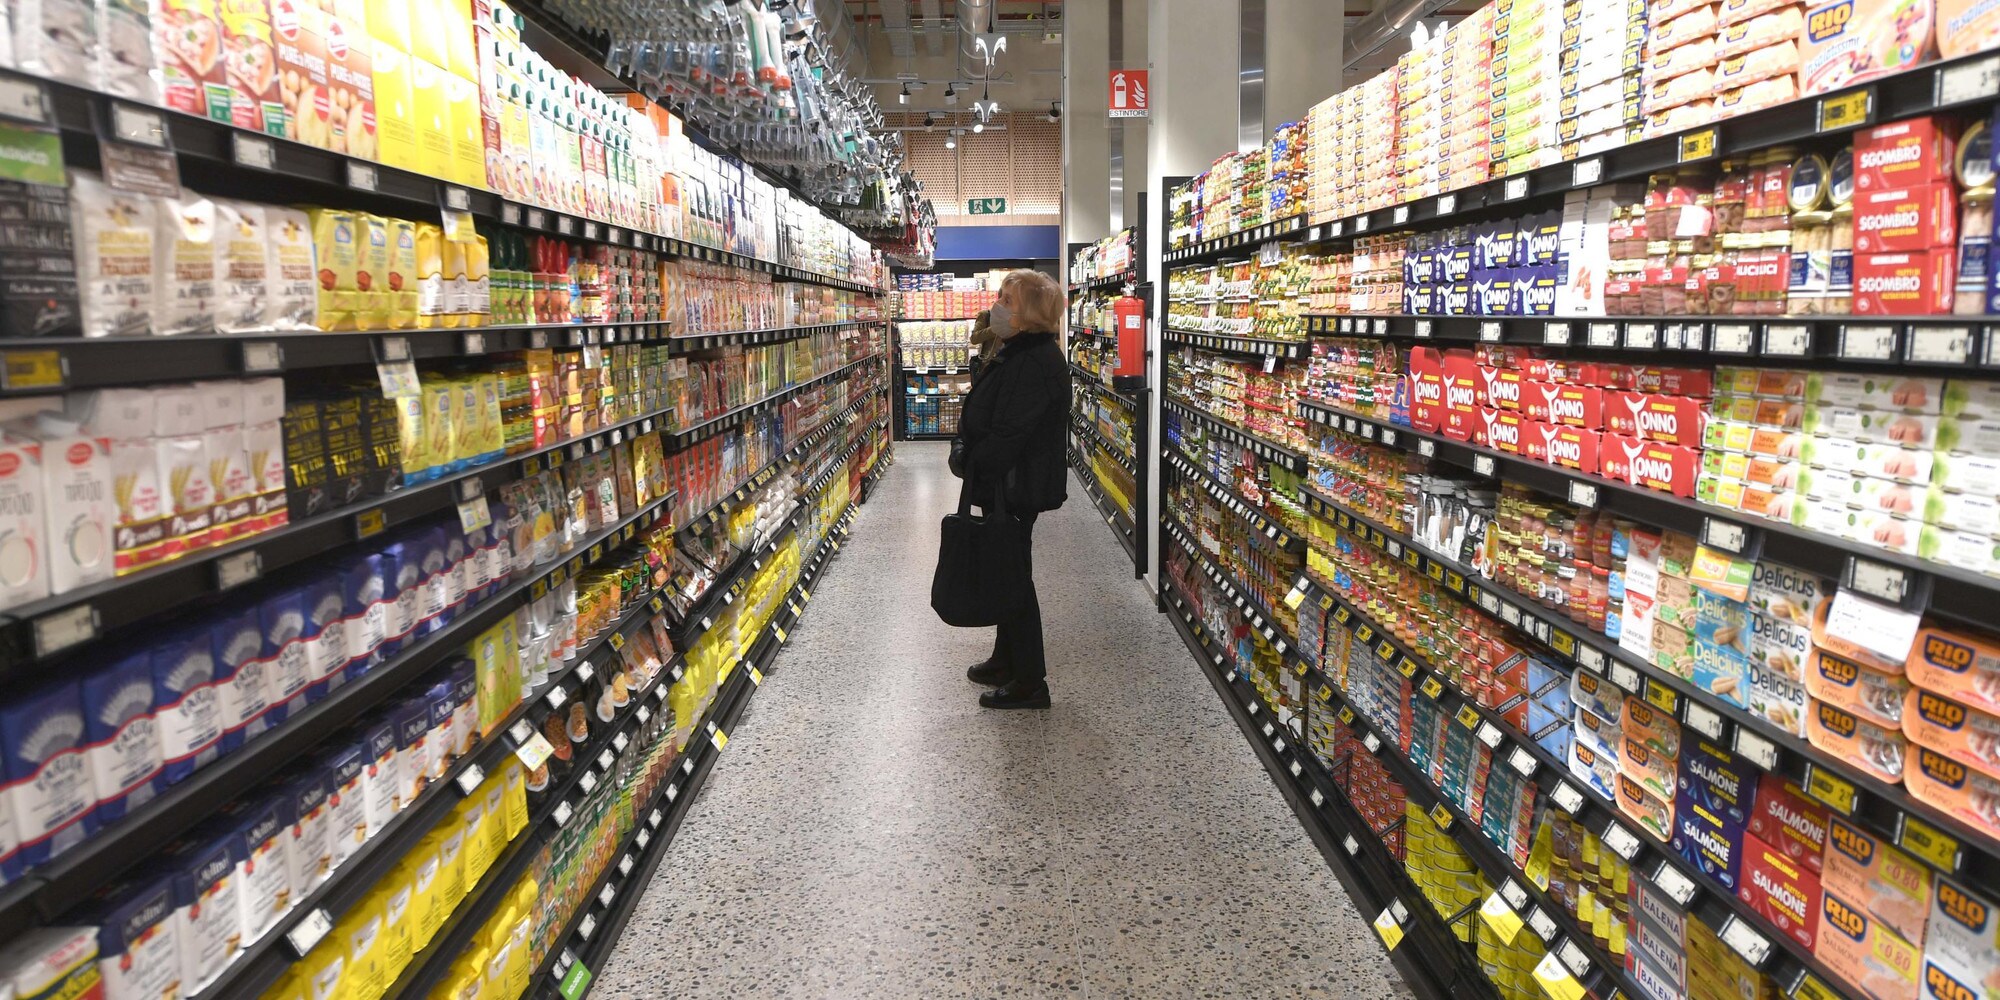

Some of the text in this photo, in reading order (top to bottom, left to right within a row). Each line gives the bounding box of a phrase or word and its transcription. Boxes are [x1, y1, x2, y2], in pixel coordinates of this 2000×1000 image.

[1564, 2, 1582, 18] RIO
[1811, 4, 1851, 33] RIO
[1563, 26, 1581, 42] RIO
[1493, 58, 1507, 72] RIO
[1492, 79, 1507, 92] RIO
[1561, 74, 1579, 88] RIO
[1491, 100, 1506, 113] RIO
[1560, 97, 1578, 111] RIO
[1492, 121, 1506, 134] RIO
[1560, 119, 1578, 134] RIO
[1491, 142, 1505, 155] RIO
[1860, 145, 1921, 168] SGOMBRO
[1859, 211, 1919, 231] SGOMBRO
[1859, 276, 1921, 292] SGOMBRO
[1752, 562, 1815, 598] Delicius
[1698, 593, 1747, 629] Delicius
[1752, 613, 1806, 652] Delicius
[1694, 641, 1743, 679] Delicius
[1927, 641, 1971, 662] RIO
[1821, 657, 1856, 679] RIO
[1580, 673, 1598, 689] RIO
[1750, 665, 1804, 707] Delicius
[1582, 712, 1599, 727] RIO
[1631, 703, 1652, 721] RIO
[1821, 707, 1855, 728] RIO
[1920, 696, 1966, 722] RIO
[1577, 744, 1594, 761] RIO
[1628, 743, 1648, 761] RIO
[1924, 754, 1966, 778] RIO
[1690, 760, 1739, 797] SALMONE
[1623, 780, 1643, 799] RIO
[1768, 801, 1825, 844] SALMONE
[1684, 821, 1730, 862] SALMONE
[1833, 823, 1871, 857] RIO
[1753, 870, 1807, 918] SALMONE
[1940, 884, 1985, 925] RIO
[1643, 896, 1680, 937] BALENA
[1826, 897, 1864, 933] RIO
[1642, 933, 1679, 973] BALENA
[1928, 966, 1976, 1000] RIO
